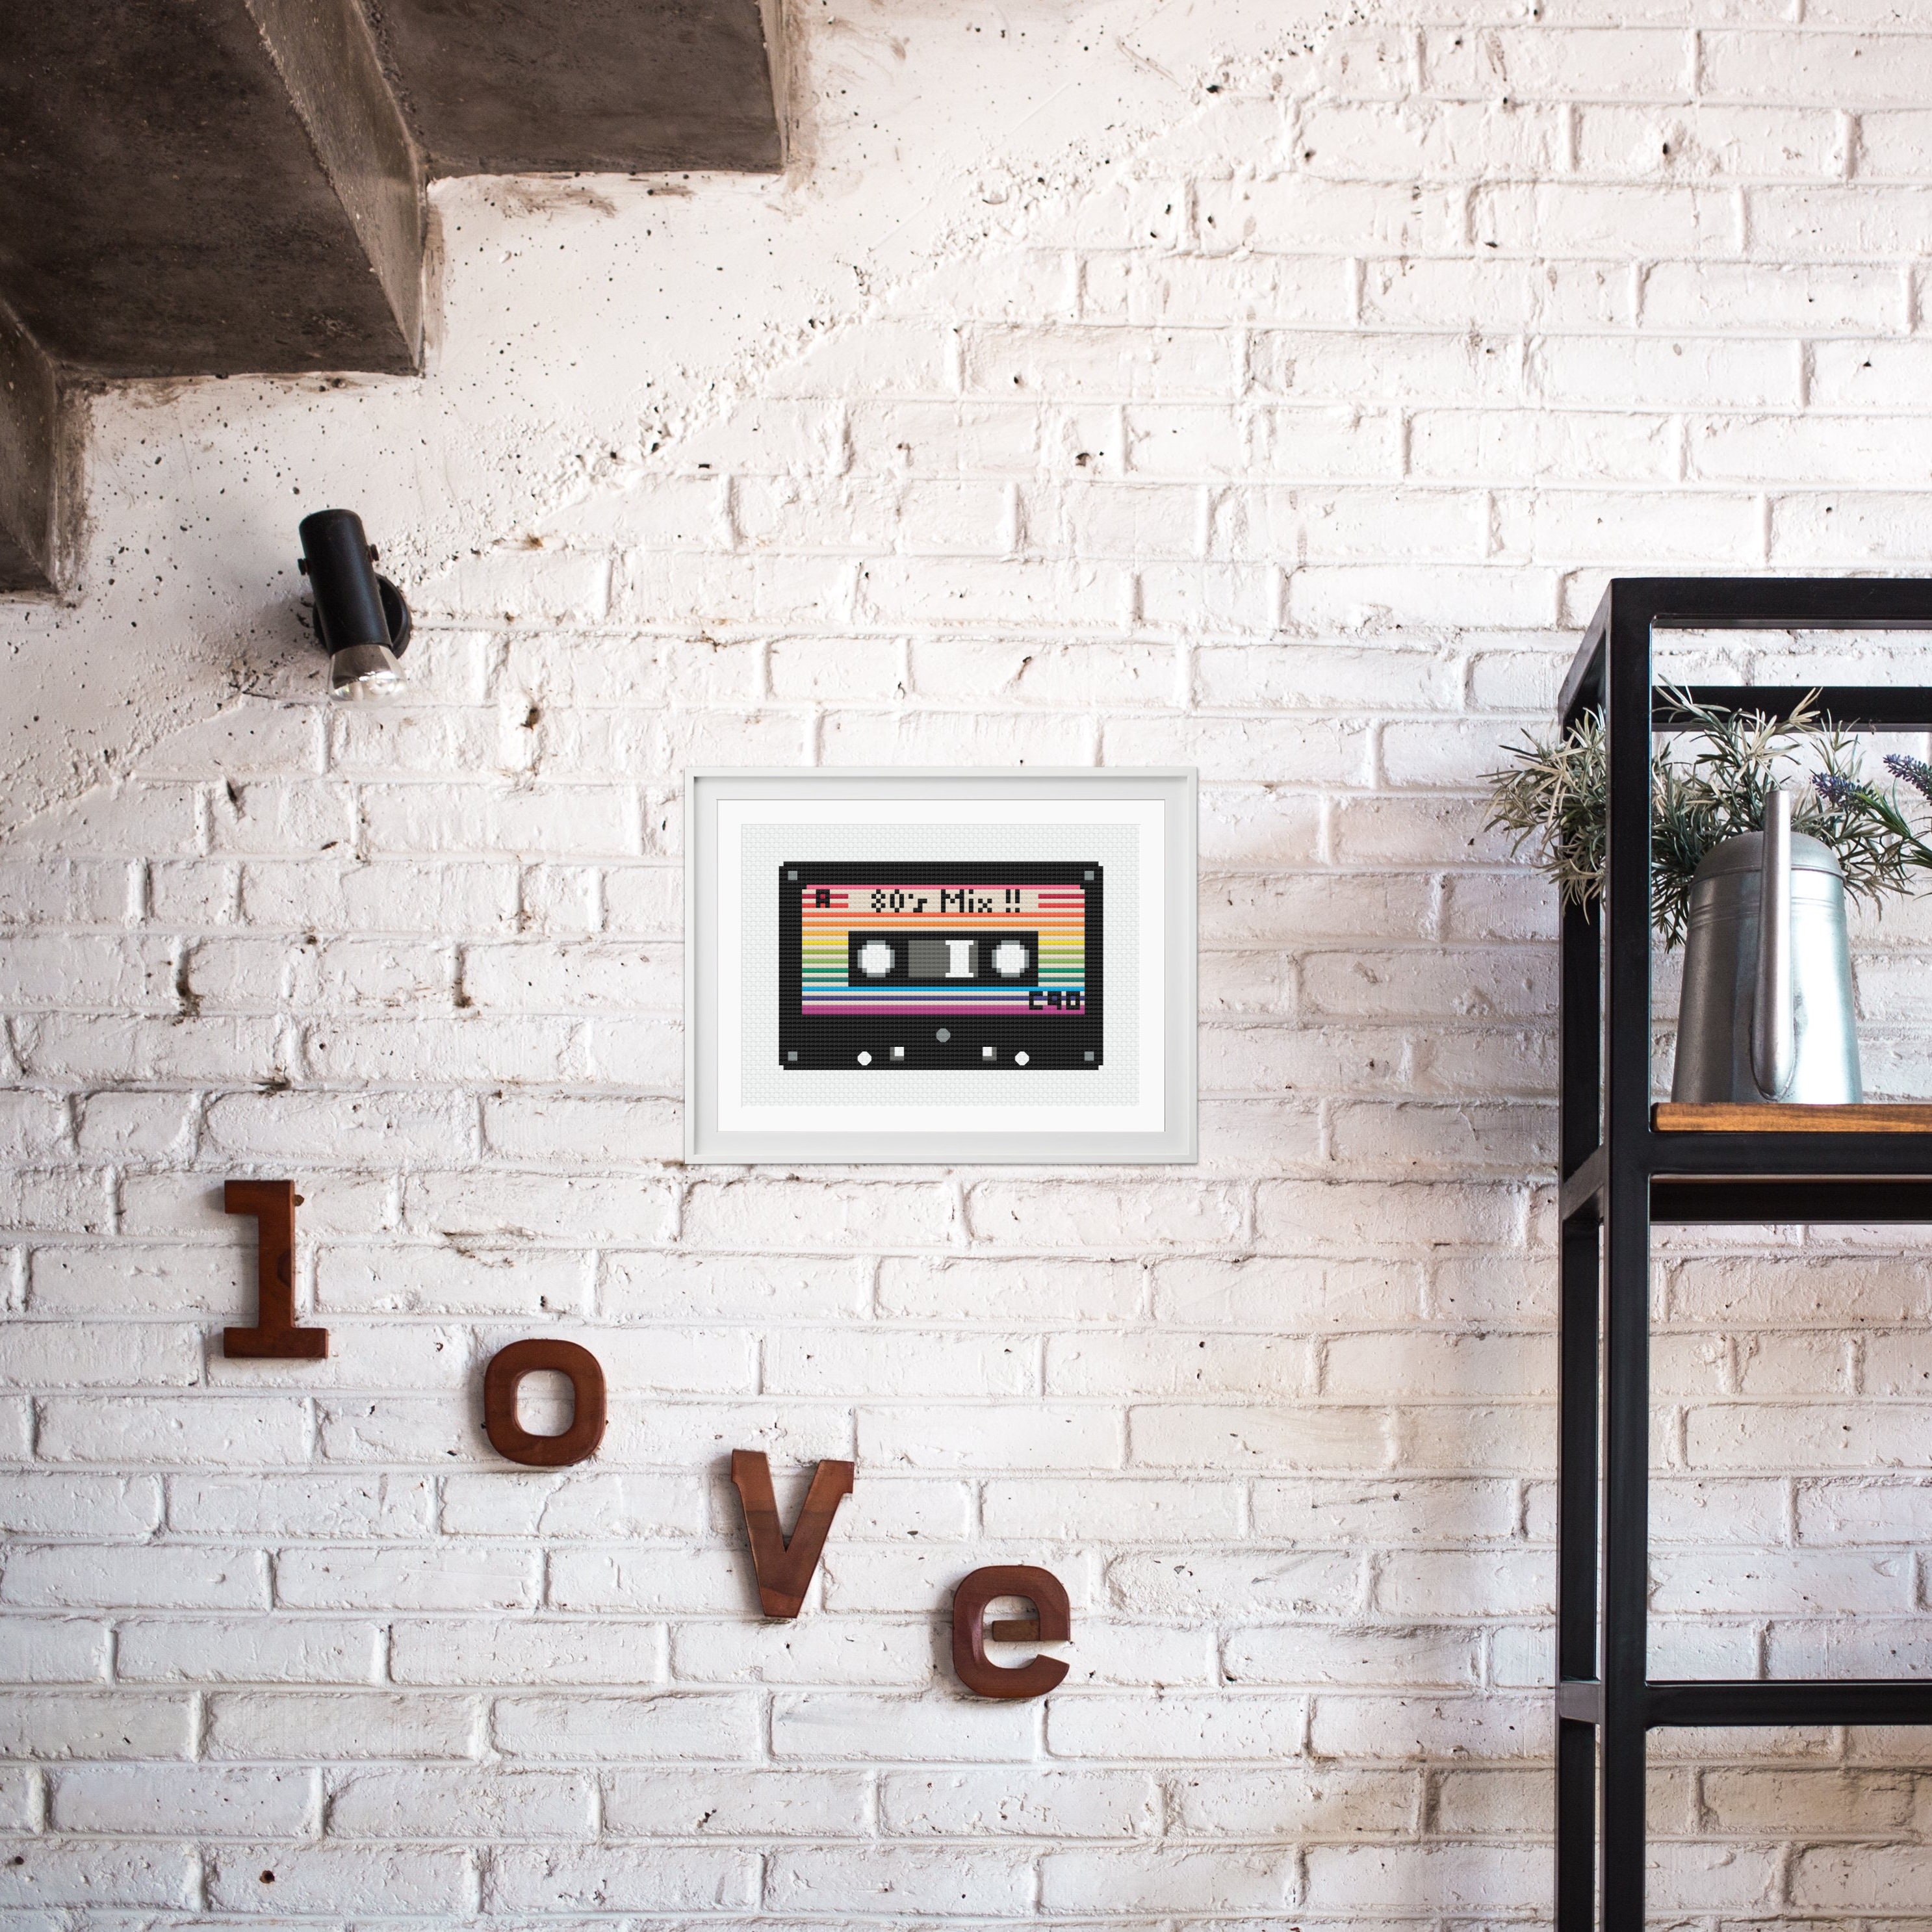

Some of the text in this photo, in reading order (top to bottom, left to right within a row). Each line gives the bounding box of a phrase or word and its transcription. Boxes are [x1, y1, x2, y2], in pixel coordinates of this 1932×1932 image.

[816, 889, 830, 908] A
[871, 889, 1020, 912] 80's Mix !!
[1029, 991, 1080, 1010] C90
